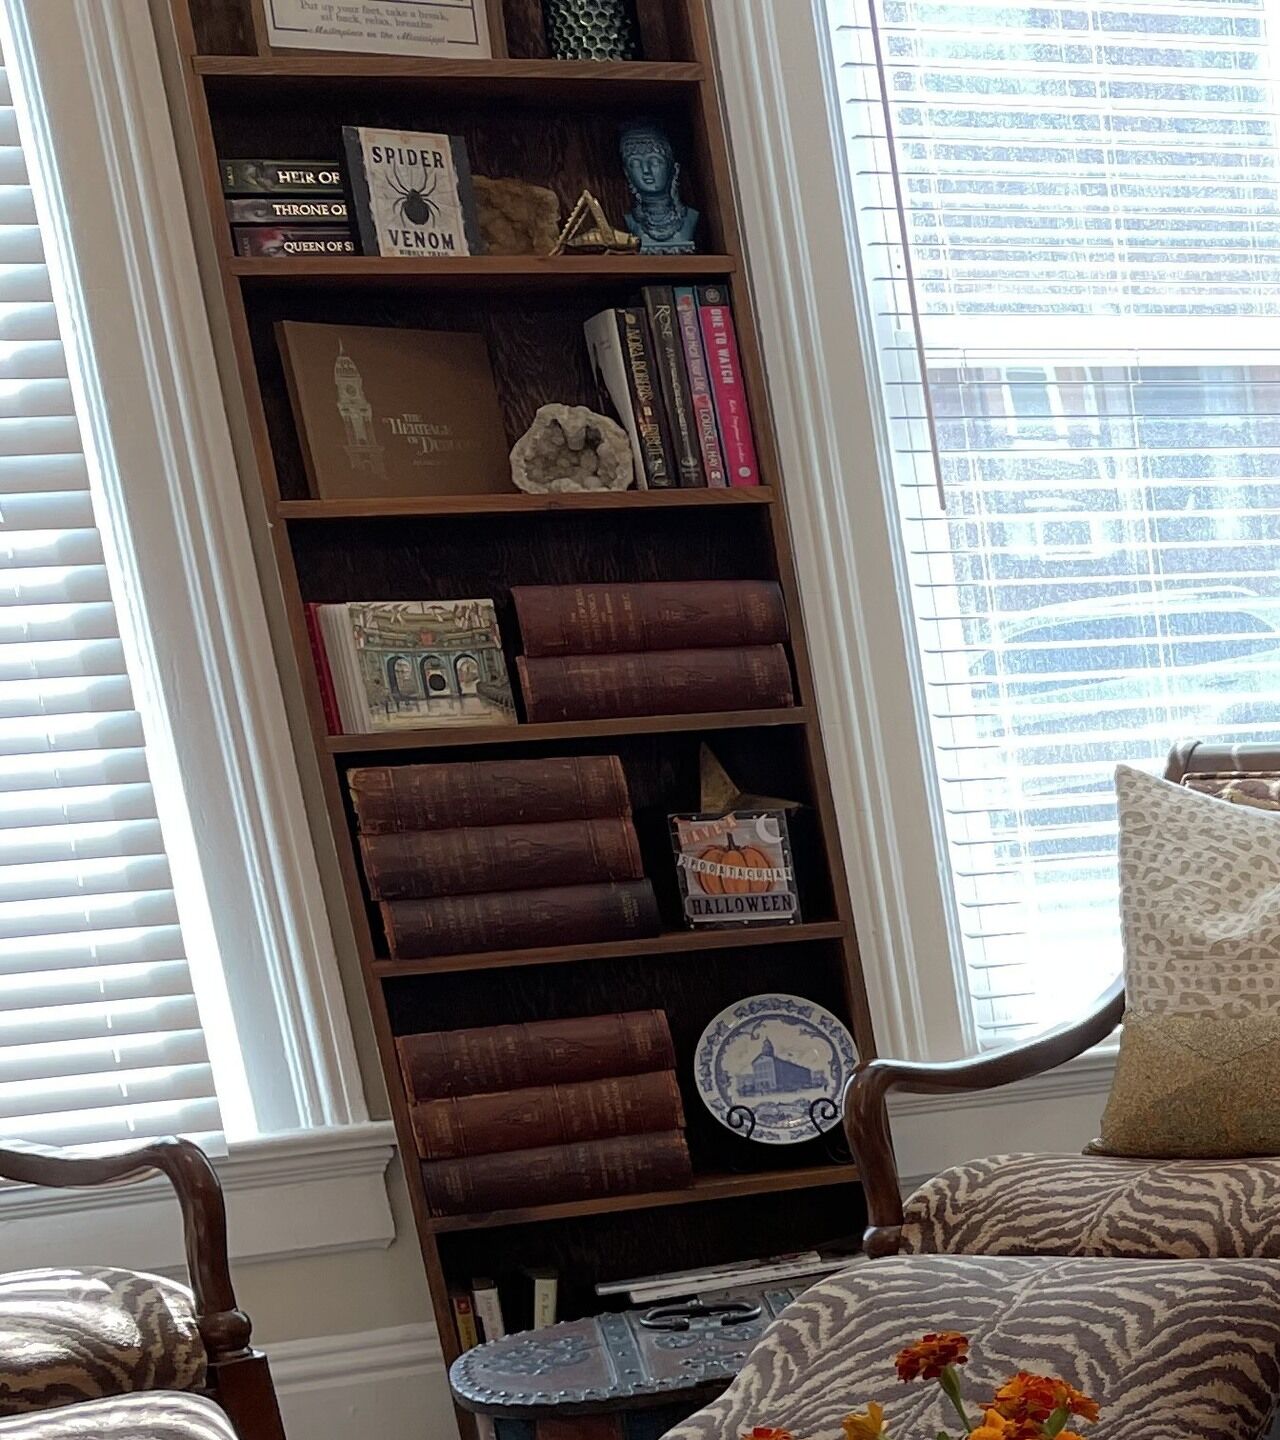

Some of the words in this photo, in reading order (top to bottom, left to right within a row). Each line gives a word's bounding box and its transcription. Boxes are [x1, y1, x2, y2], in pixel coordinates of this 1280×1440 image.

[372, 146, 445, 169] SPIDER
[277, 170, 315, 184] HEIR
[318, 171, 341, 184] OF
[272, 204, 329, 216] THRONE
[284, 241, 325, 252] QUEEN
[327, 241, 343, 251] OF
[388, 229, 455, 250] VENOM
[653, 304, 673, 338] ROSE
[710, 308, 724, 329] ONE
[626, 328, 645, 362] NORA
[714, 332, 727, 345] TO
[686, 340, 700, 360] Heal
[718, 348, 734, 384] WATCH
[632, 360, 654, 404] ROBERTS
[700, 408, 716, 443] LOUISE
[707, 451, 721, 468] HAY
[681, 823, 722, 845] HAVE
[681, 857, 792, 879] SPOOKTACULAR
[692, 895, 792, 915] HALLOWEEN
